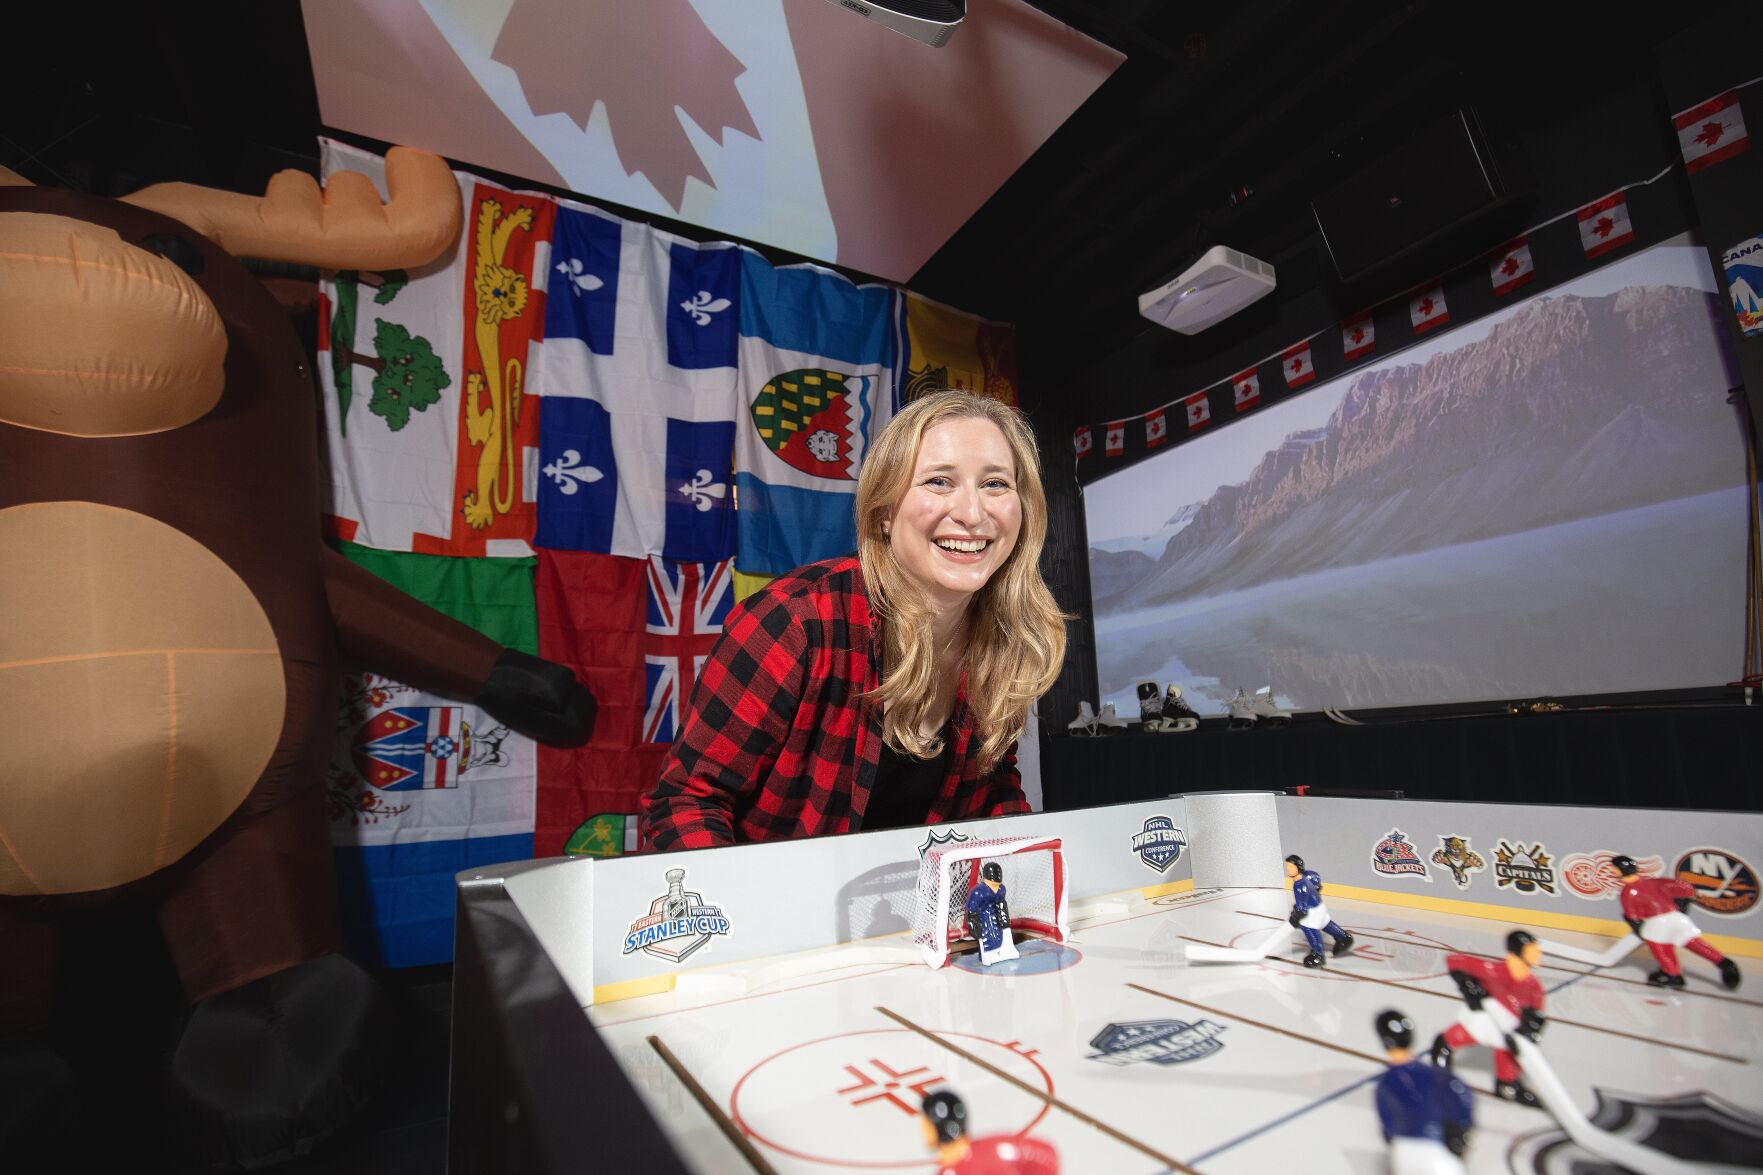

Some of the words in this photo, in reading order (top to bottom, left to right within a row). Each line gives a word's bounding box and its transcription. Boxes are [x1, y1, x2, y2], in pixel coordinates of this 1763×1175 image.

[1148, 821, 1169, 830] NHL
[1134, 829, 1186, 847] WESTERN
[1145, 844, 1175, 854] CONFERENCE
[1376, 861, 1394, 872] BLUE
[1394, 863, 1425, 875] JACKETS
[1498, 865, 1551, 881] CAPITALS
[626, 918, 695, 951] STANLEY
[697, 917, 729, 932] CUP
